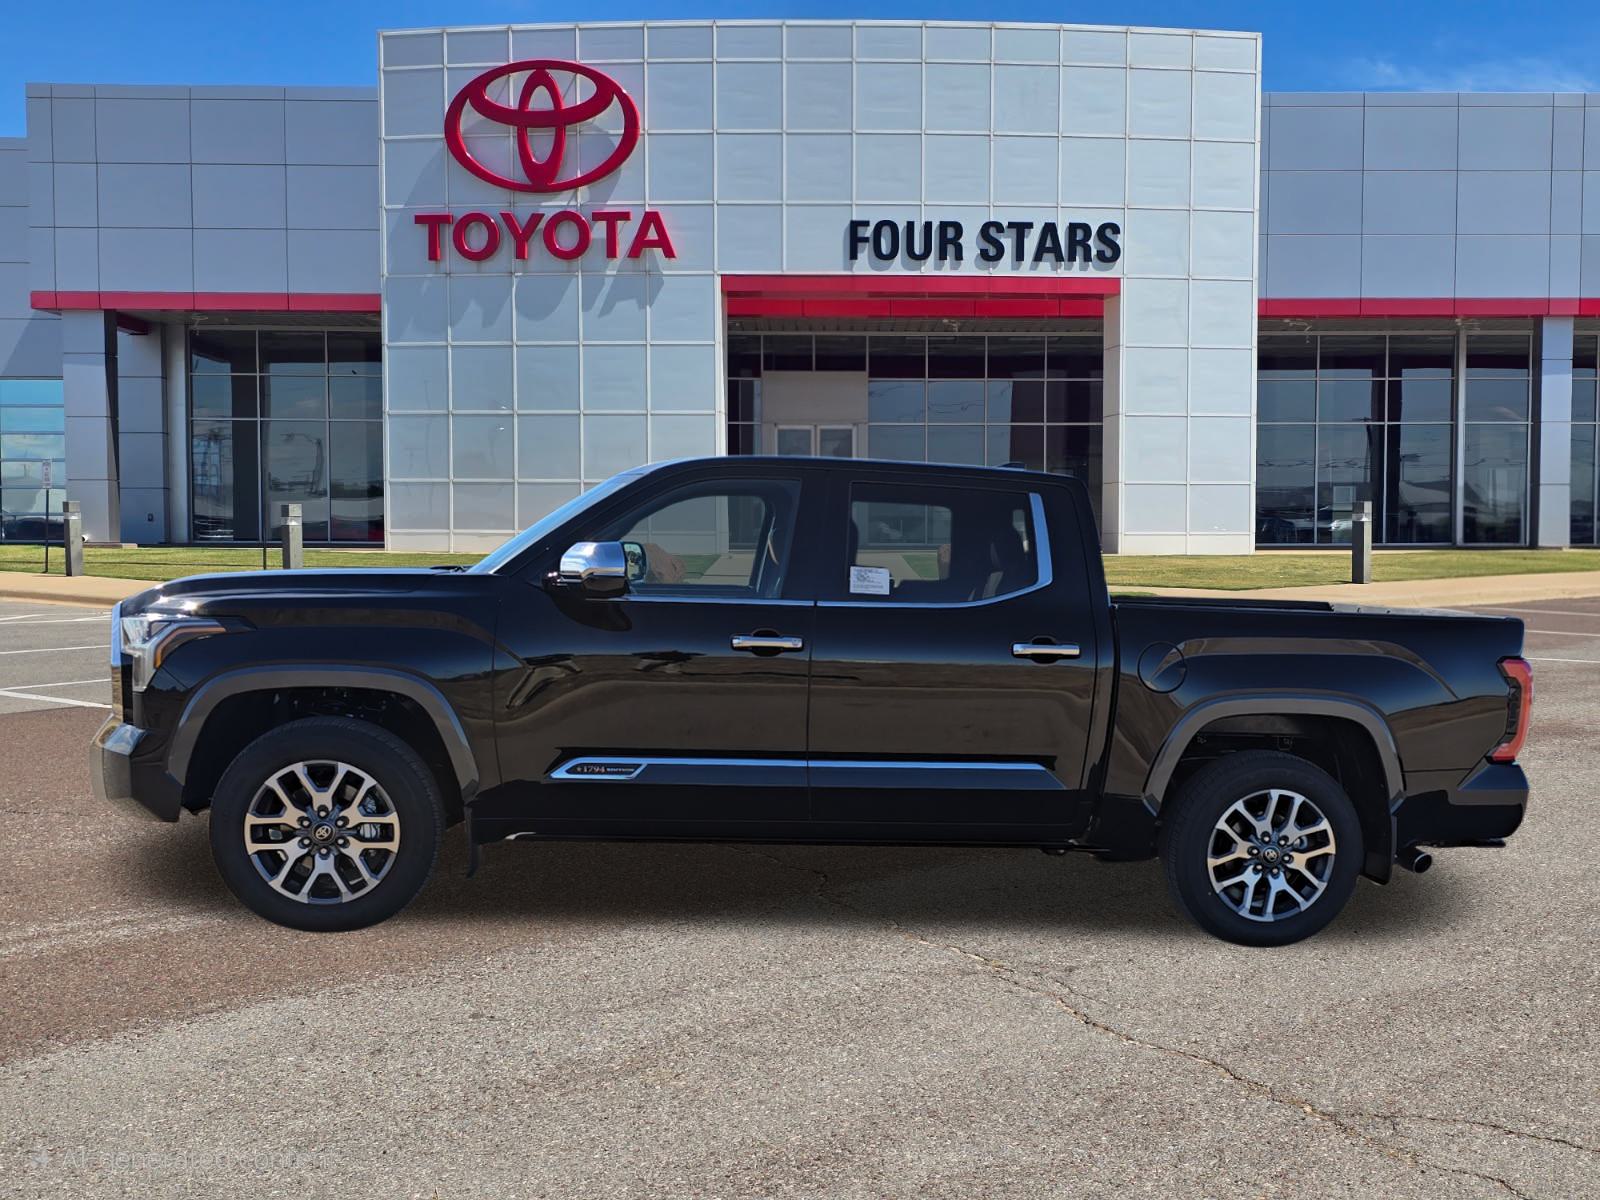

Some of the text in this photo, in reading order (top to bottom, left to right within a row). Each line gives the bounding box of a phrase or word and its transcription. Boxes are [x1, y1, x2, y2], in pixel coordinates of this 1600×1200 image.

[414, 210, 677, 262] TOYOTA
[850, 219, 1121, 264] FOUR STARS
